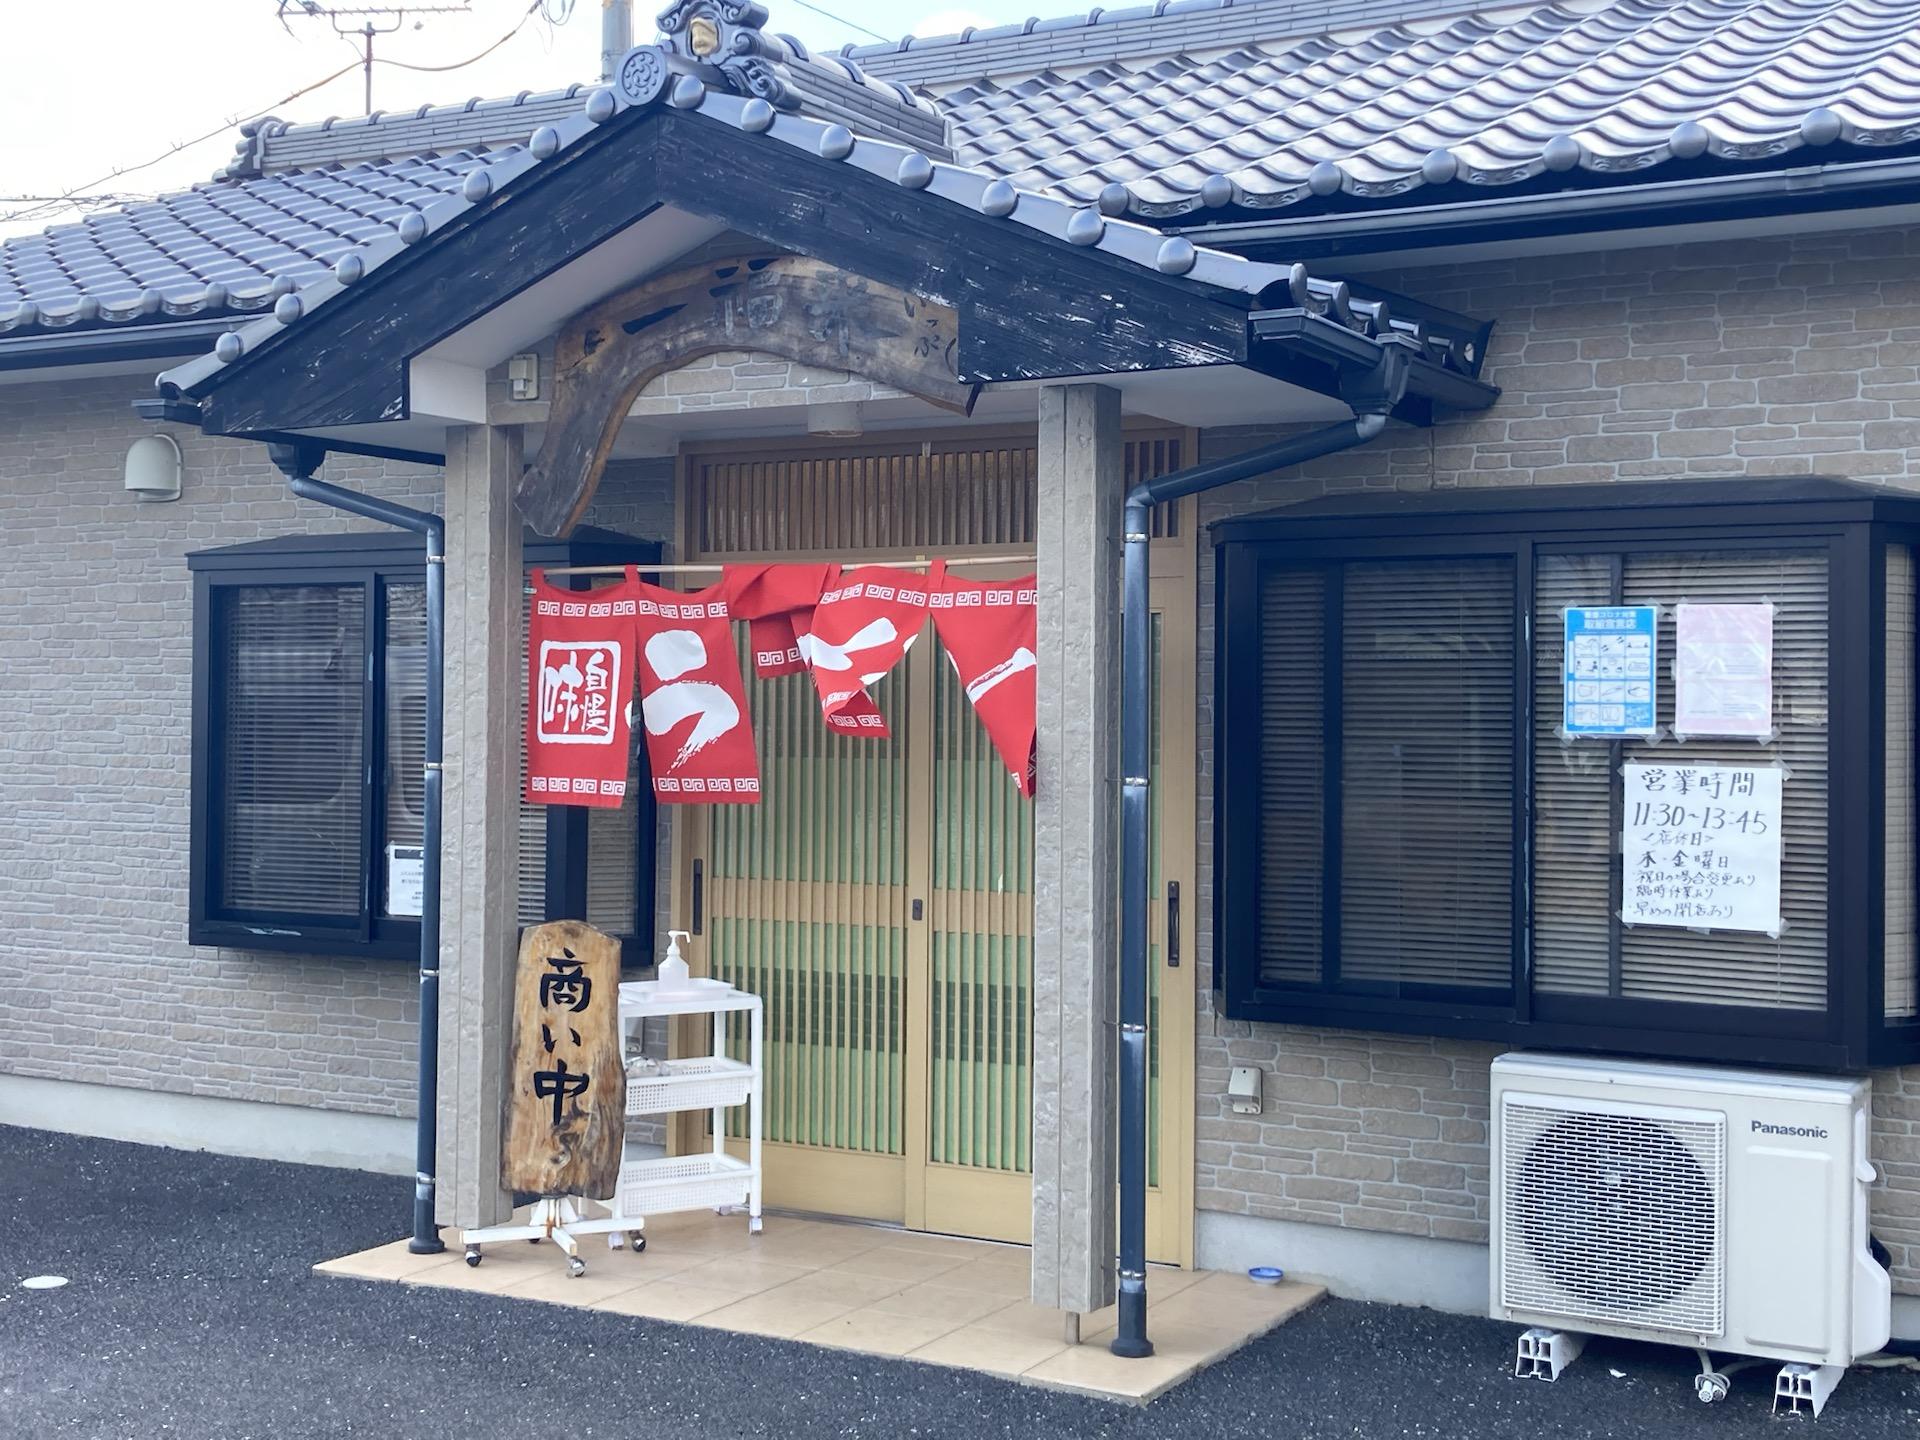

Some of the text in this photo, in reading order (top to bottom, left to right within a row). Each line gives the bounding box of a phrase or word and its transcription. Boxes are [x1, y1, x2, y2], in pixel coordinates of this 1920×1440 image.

[1641, 768, 1755, 800] 営業時間
[533, 948, 592, 1126] 商い中
[1751, 1119, 1829, 1139] Panasonic
